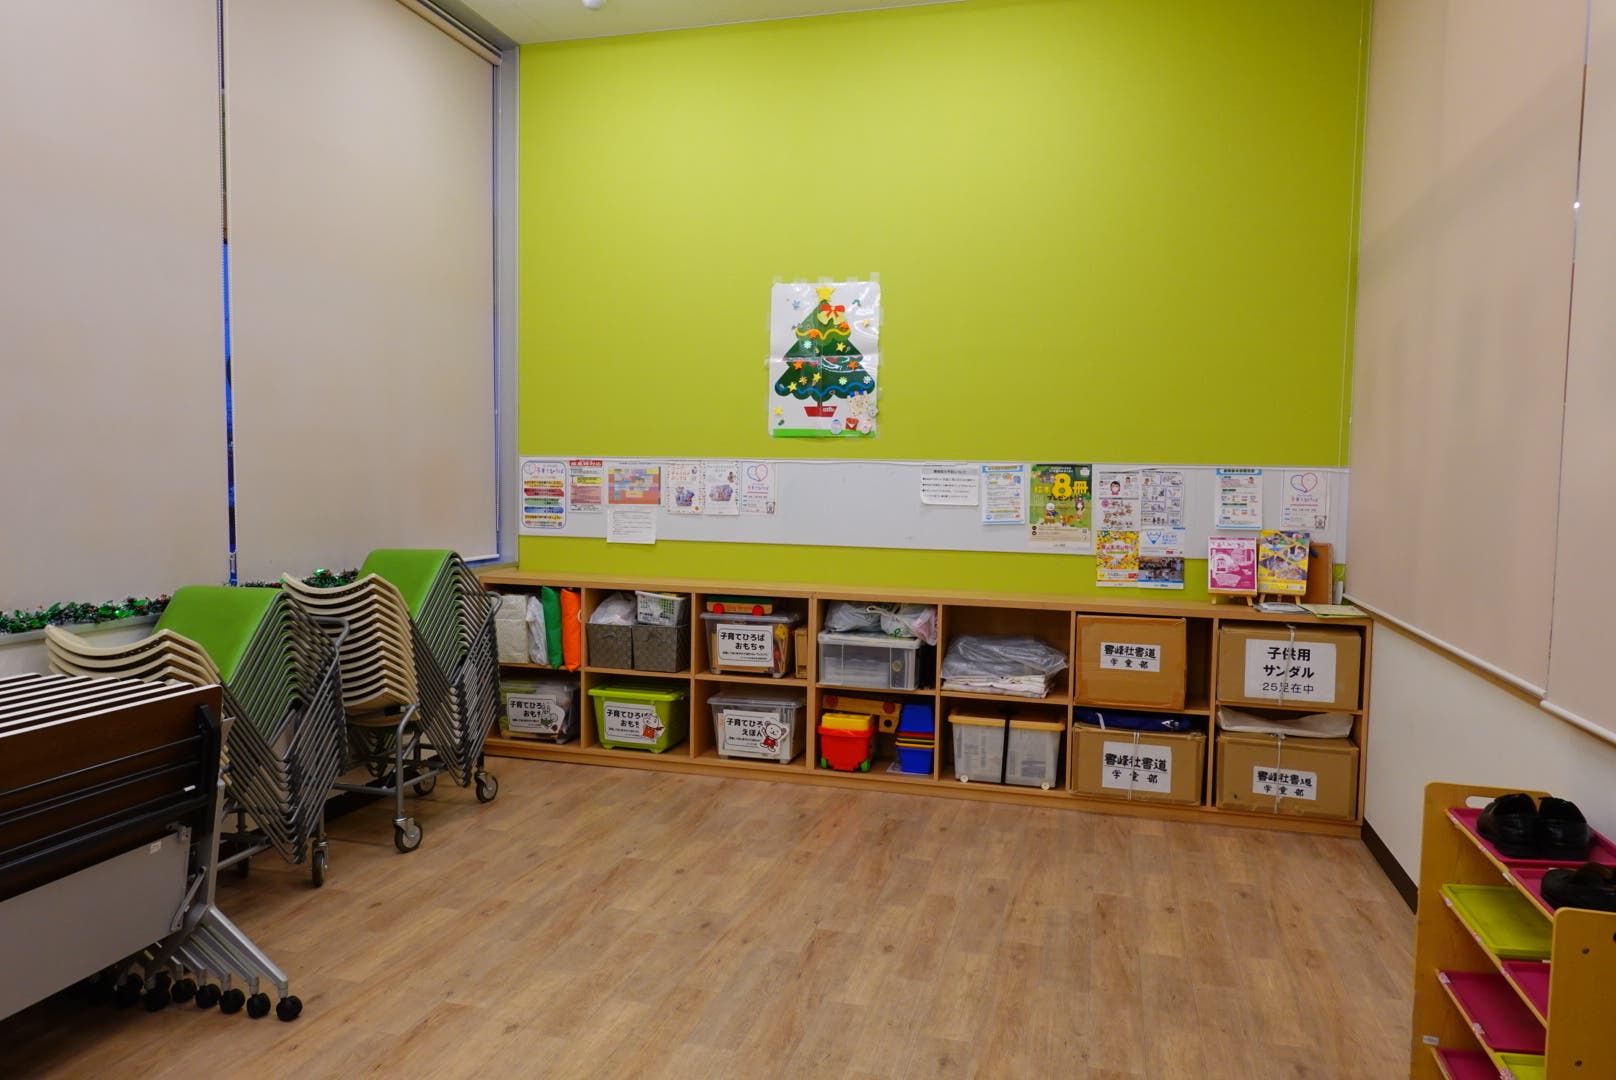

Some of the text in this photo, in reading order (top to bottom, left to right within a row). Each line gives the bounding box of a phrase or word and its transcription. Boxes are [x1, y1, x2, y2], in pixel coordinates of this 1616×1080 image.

[720, 632, 765, 641] 子育てひろば
[736, 642, 765, 651] おもちゃ
[1267, 646, 1311, 662] 子供用
[1263, 664, 1315, 678] サンダル
[1262, 682, 1314, 695] 25足在中
[742, 728, 763, 737] えほん
